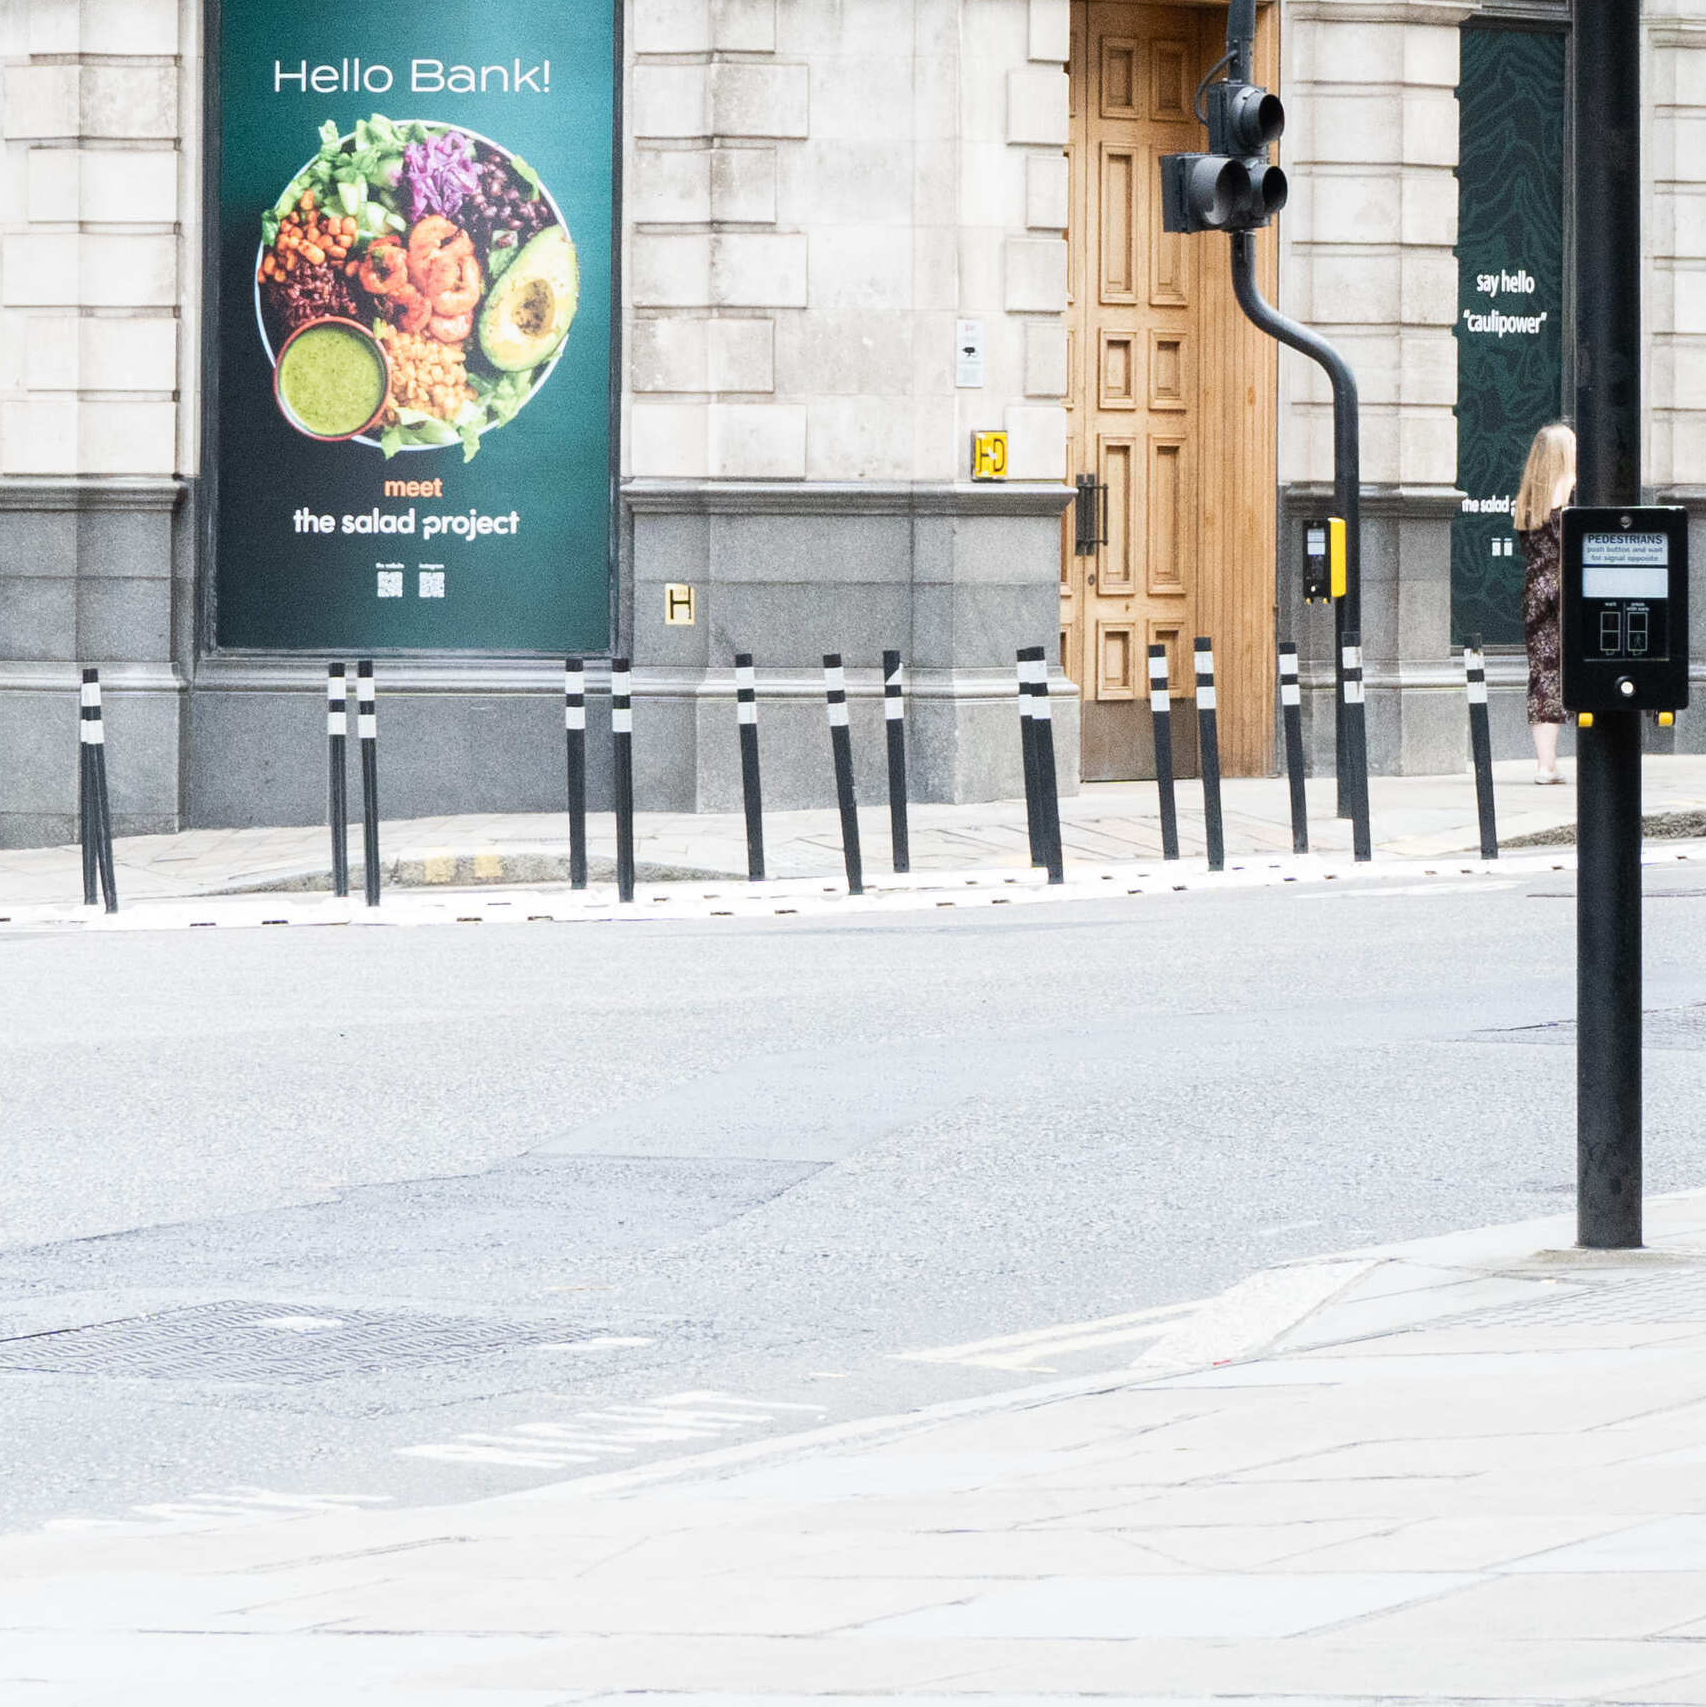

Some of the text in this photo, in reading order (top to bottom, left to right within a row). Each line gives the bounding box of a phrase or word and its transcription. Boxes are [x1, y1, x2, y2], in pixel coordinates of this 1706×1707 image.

[274, 58, 551, 94] Hello Bank!
[1476, 269, 1535, 297] say hello
[383, 477, 443, 498] meet
[1480, 494, 1510, 513] salad
[293, 507, 520, 542] the salad project
[1587, 534, 1663, 544] PEDESTRIANS
[1604, 555, 1626, 563] signal
[1627, 555, 1659, 563] opposite
[669, 586, 692, 620] H
